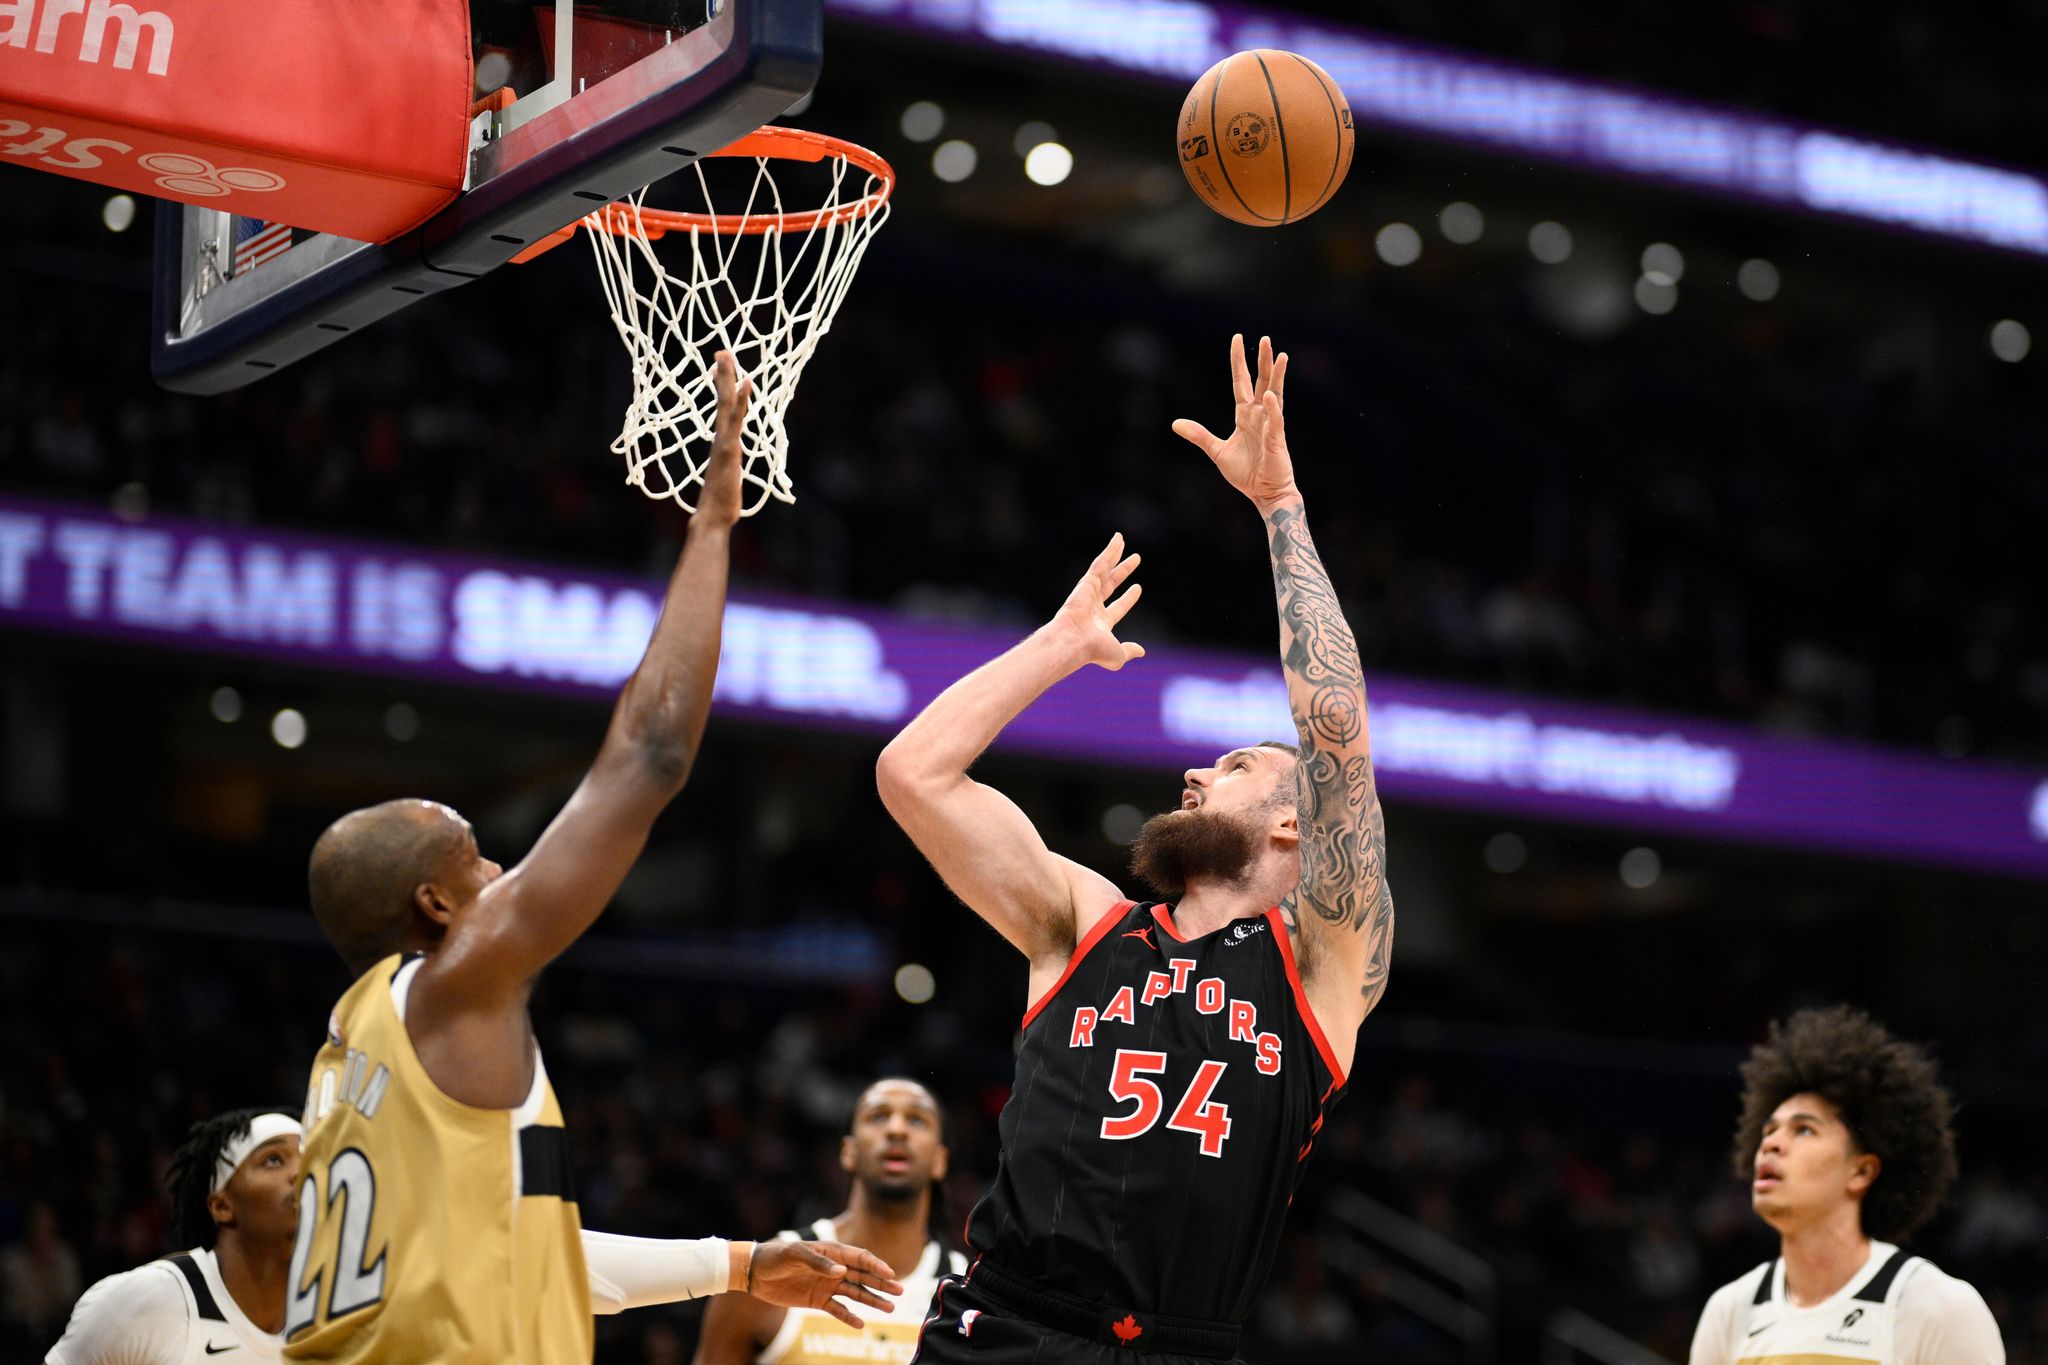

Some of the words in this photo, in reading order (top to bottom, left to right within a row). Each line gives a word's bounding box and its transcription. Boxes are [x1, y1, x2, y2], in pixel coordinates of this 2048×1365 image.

[55, 520, 338, 647] TEAM
[1069, 958, 1282, 1076] RAPTORS
[1100, 1048, 1232, 1158] 54
[285, 1146, 388, 1344] 22
